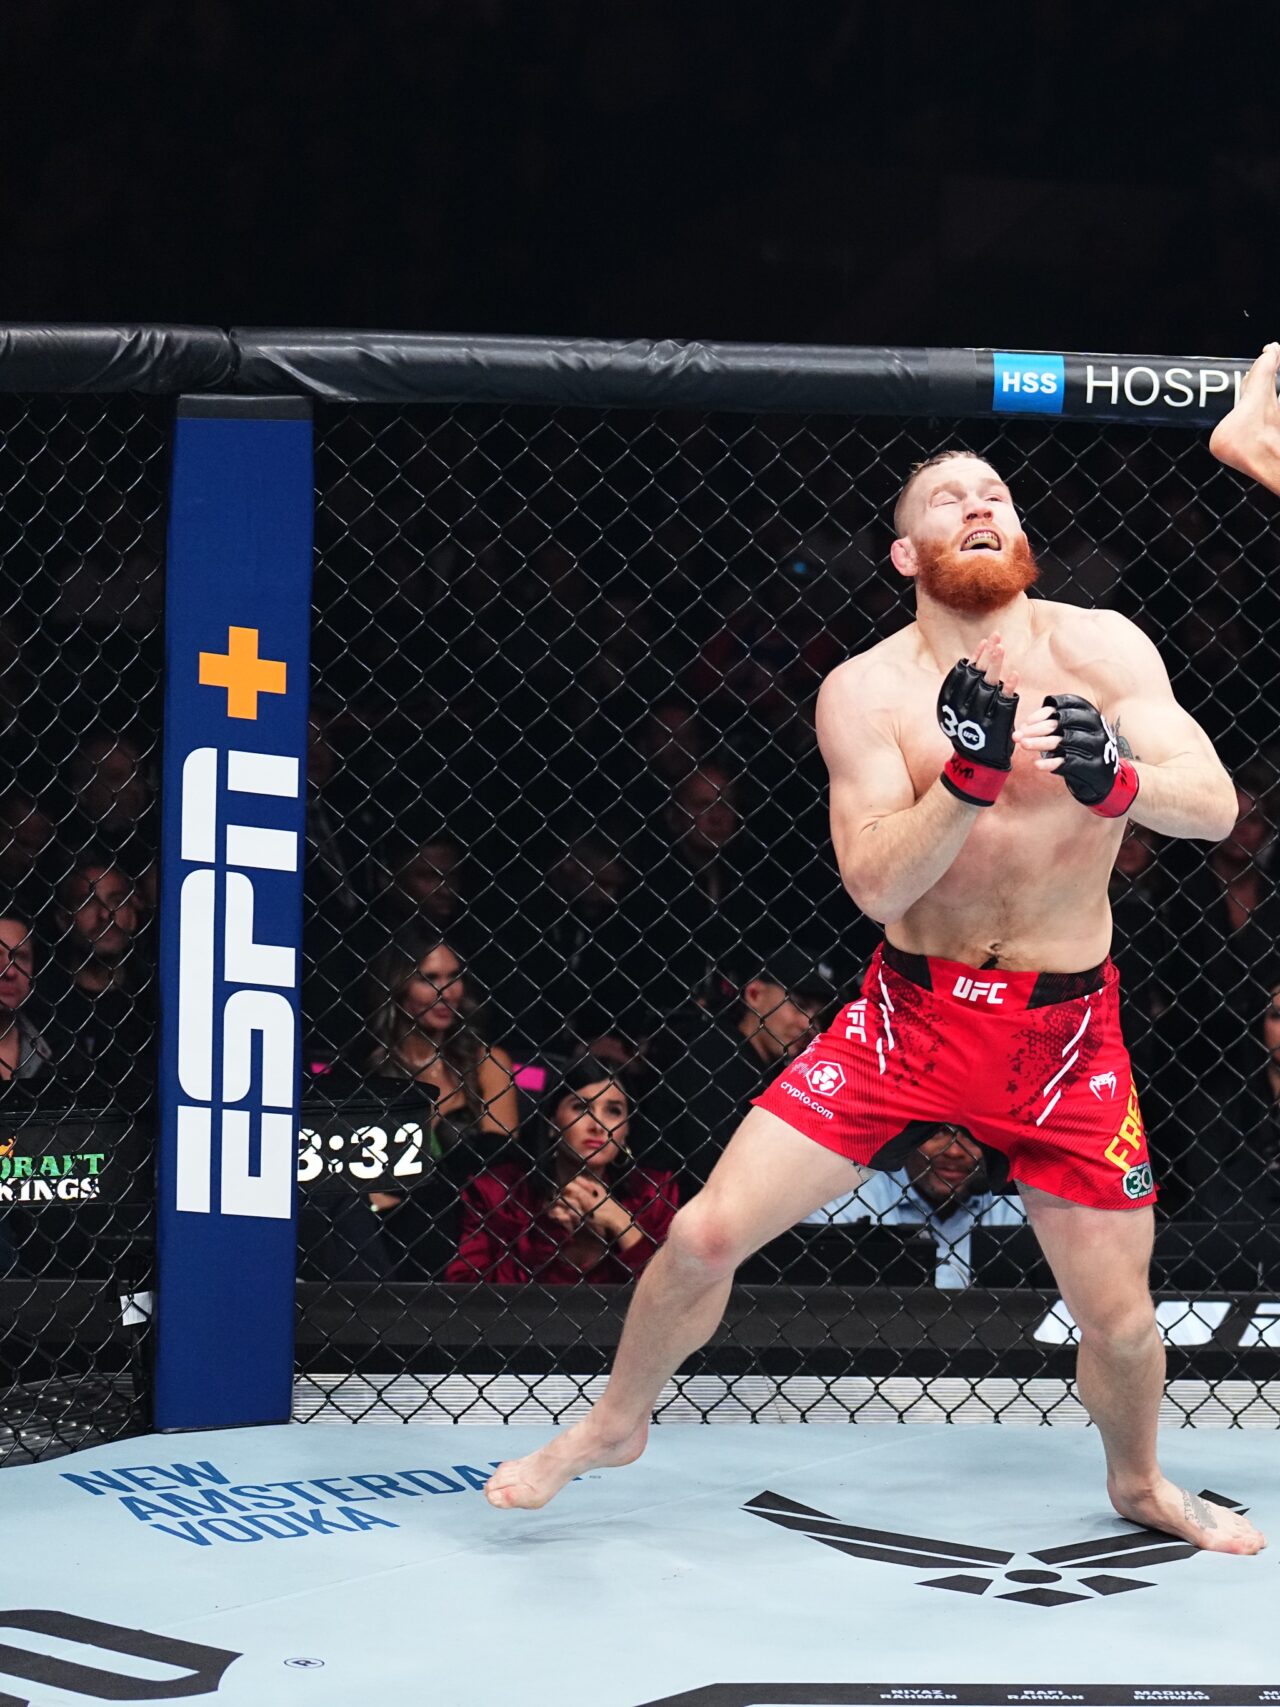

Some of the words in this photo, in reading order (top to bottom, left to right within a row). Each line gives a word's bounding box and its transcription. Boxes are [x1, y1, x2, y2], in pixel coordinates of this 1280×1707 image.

[1002, 371, 1057, 395] HSS
[952, 976, 1008, 1005] UFC
[780, 1079, 834, 1120] crypto.com
[1104, 1073, 1142, 1173] FRE
[60, 1461, 230, 1495] NEW
[118, 1461, 583, 1521] AMSTERDA
[148, 1508, 402, 1546] VODKA
